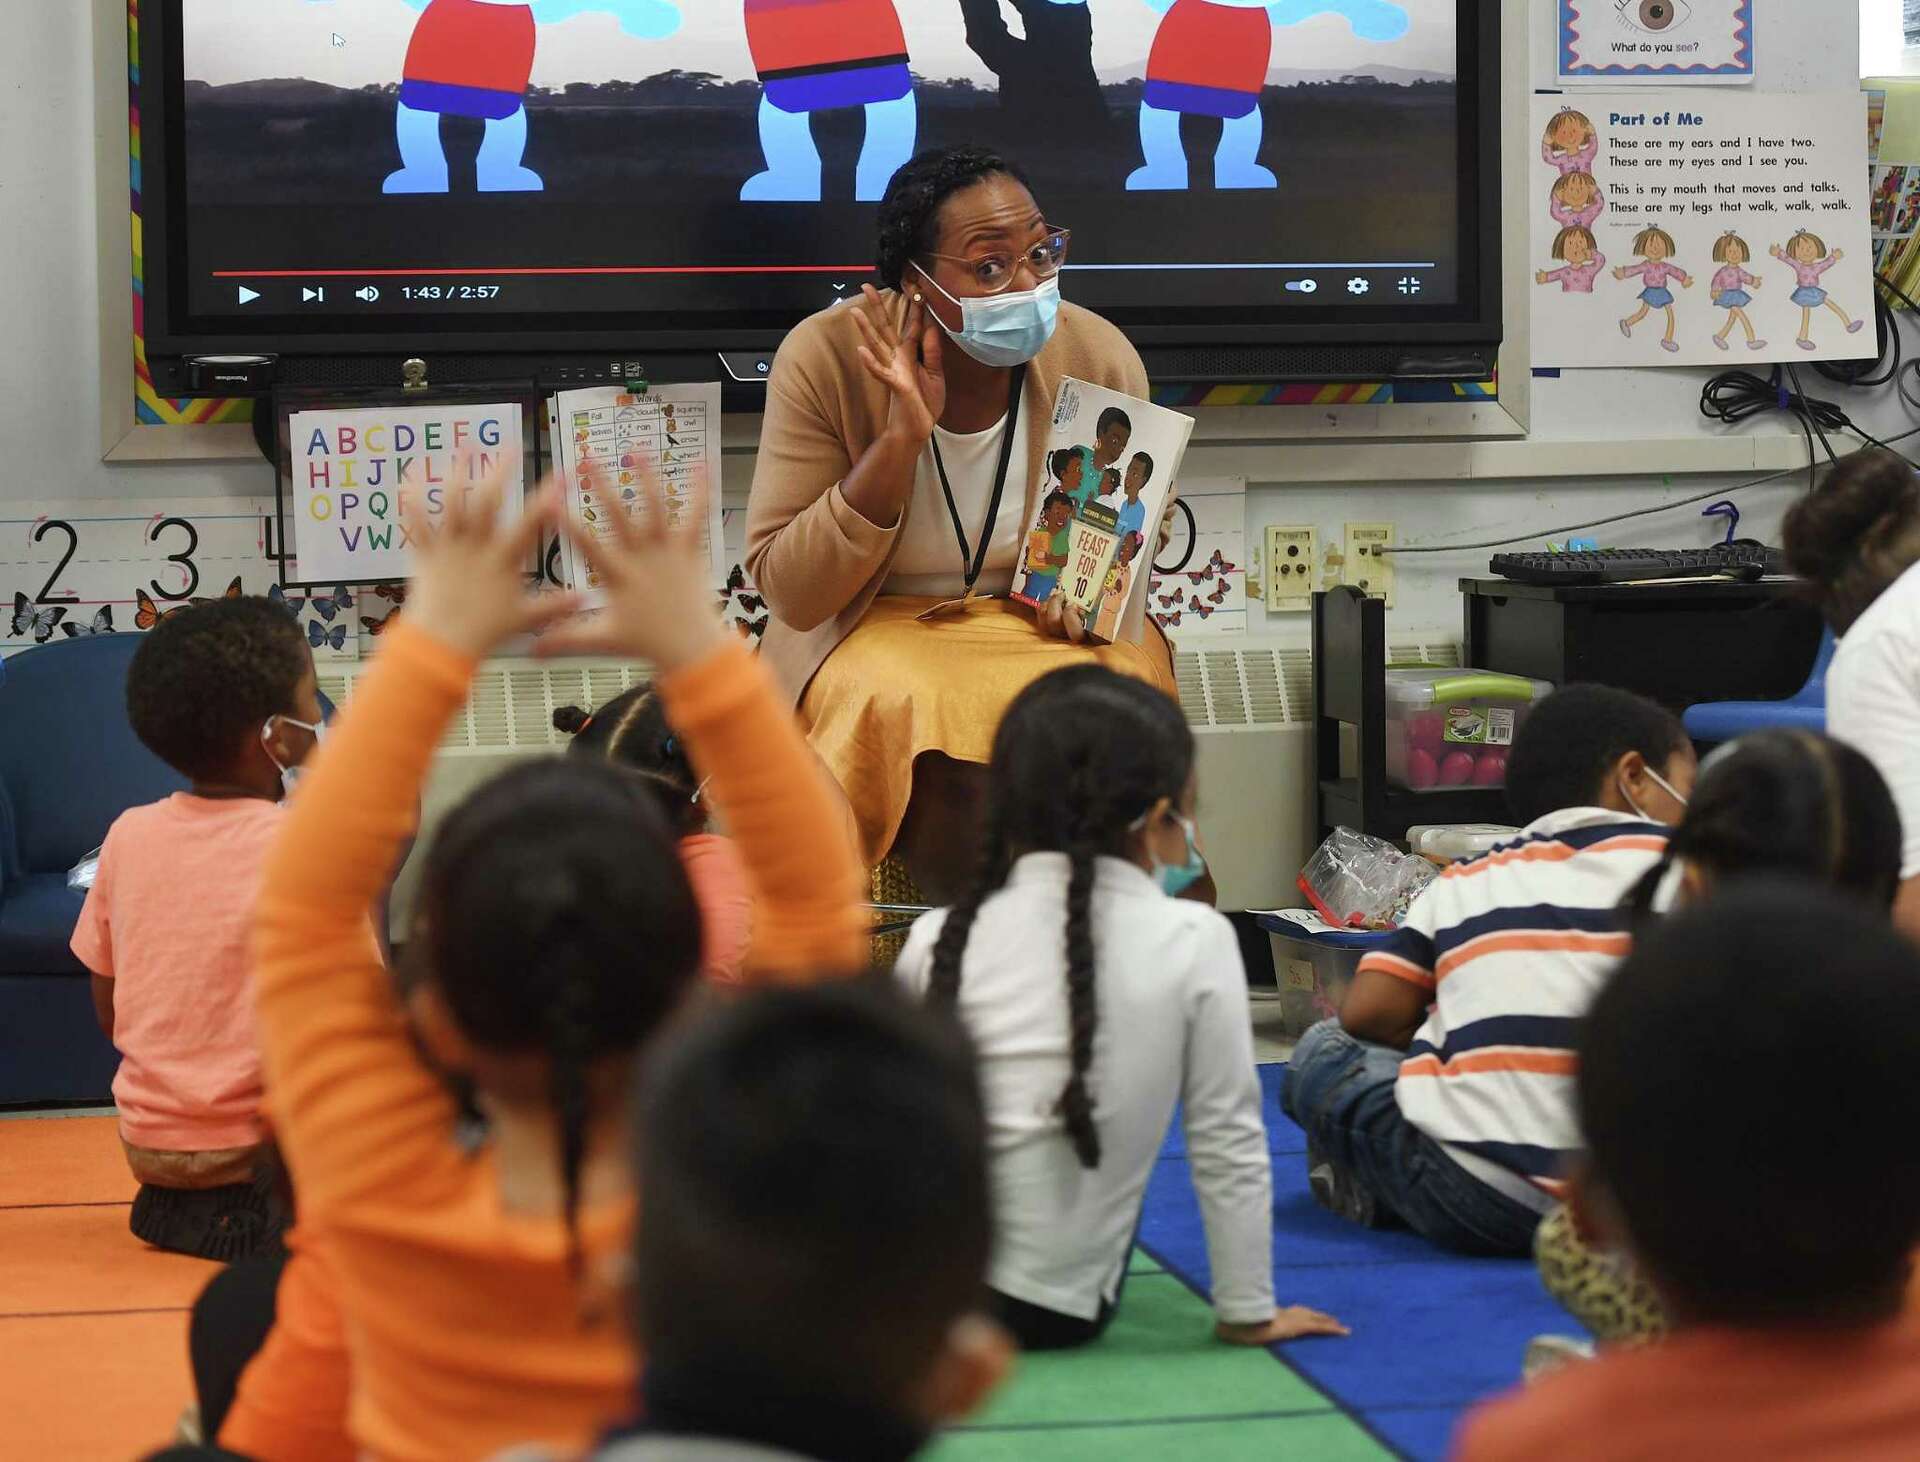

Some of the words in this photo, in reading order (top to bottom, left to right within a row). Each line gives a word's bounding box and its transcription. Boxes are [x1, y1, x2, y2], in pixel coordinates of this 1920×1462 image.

[1611, 42, 1636, 52] What
[1640, 42, 1652, 52] do
[1654, 44, 1673, 54] you
[1676, 42, 1699, 53] see?
[1610, 112, 1645, 125] Part
[1653, 112, 1670, 125] of
[1677, 113, 1703, 125] Me
[1609, 138, 1638, 148] These
[1645, 140, 1662, 148] are
[1669, 140, 1684, 151] my
[1692, 140, 1713, 148] ears
[1720, 137, 1740, 147] and
[1748, 137, 1751, 147] I
[1758, 137, 1784, 147] have
[1792, 138, 1815, 147] two.
[1610, 156, 1638, 166] These
[1669, 159, 1684, 169] my
[1692, 159, 1715, 169] eyes
[1722, 155, 1742, 166] and
[1749, 156, 1753, 166] I
[1785, 158, 1807, 168] you.
[1610, 183, 1629, 194] This
[1636, 184, 1644, 193] is
[1651, 187, 1666, 197] my
[1674, 183, 1707, 193] mouth
[1714, 183, 1735, 193] that
[1743, 185, 1776, 193] moves
[1783, 182, 1804, 192] and
[1811, 181, 1840, 192] talks.
[1610, 202, 1638, 212] These
[1670, 205, 1685, 215] my
[1693, 202, 1713, 214] legs
[1720, 201, 1741, 211] that
[1749, 200, 1778, 212] walk,
[1786, 200, 1814, 212] walk,
[1822, 199, 1852, 210] walk.
[402, 286, 441, 299] 1:43
[446, 286, 454, 299] /
[460, 286, 500, 299] 2:57
[307, 428, 330, 455] A
[338, 427, 357, 454] B
[365, 425, 385, 452] C
[394, 425, 415, 451] D
[425, 423, 442, 449] E
[454, 421, 470, 448] F
[479, 419, 500, 446] G
[309, 461, 330, 488] H
[340, 460, 358, 487] I
[367, 459, 386, 485] J
[396, 456, 414, 484] K
[425, 456, 443, 482] L
[310, 494, 332, 521] O
[341, 493, 359, 520] P
[368, 491, 388, 519] Q
[427, 488, 444, 514] S
[339, 526, 362, 552] V
[367, 524, 392, 550] W
[1077, 530, 1110, 558] FEAST
[34, 519, 80, 603] 2
[150, 517, 199, 602] 3
[1076, 554, 1097, 578] FOR
[1074, 577, 1088, 599] 10
